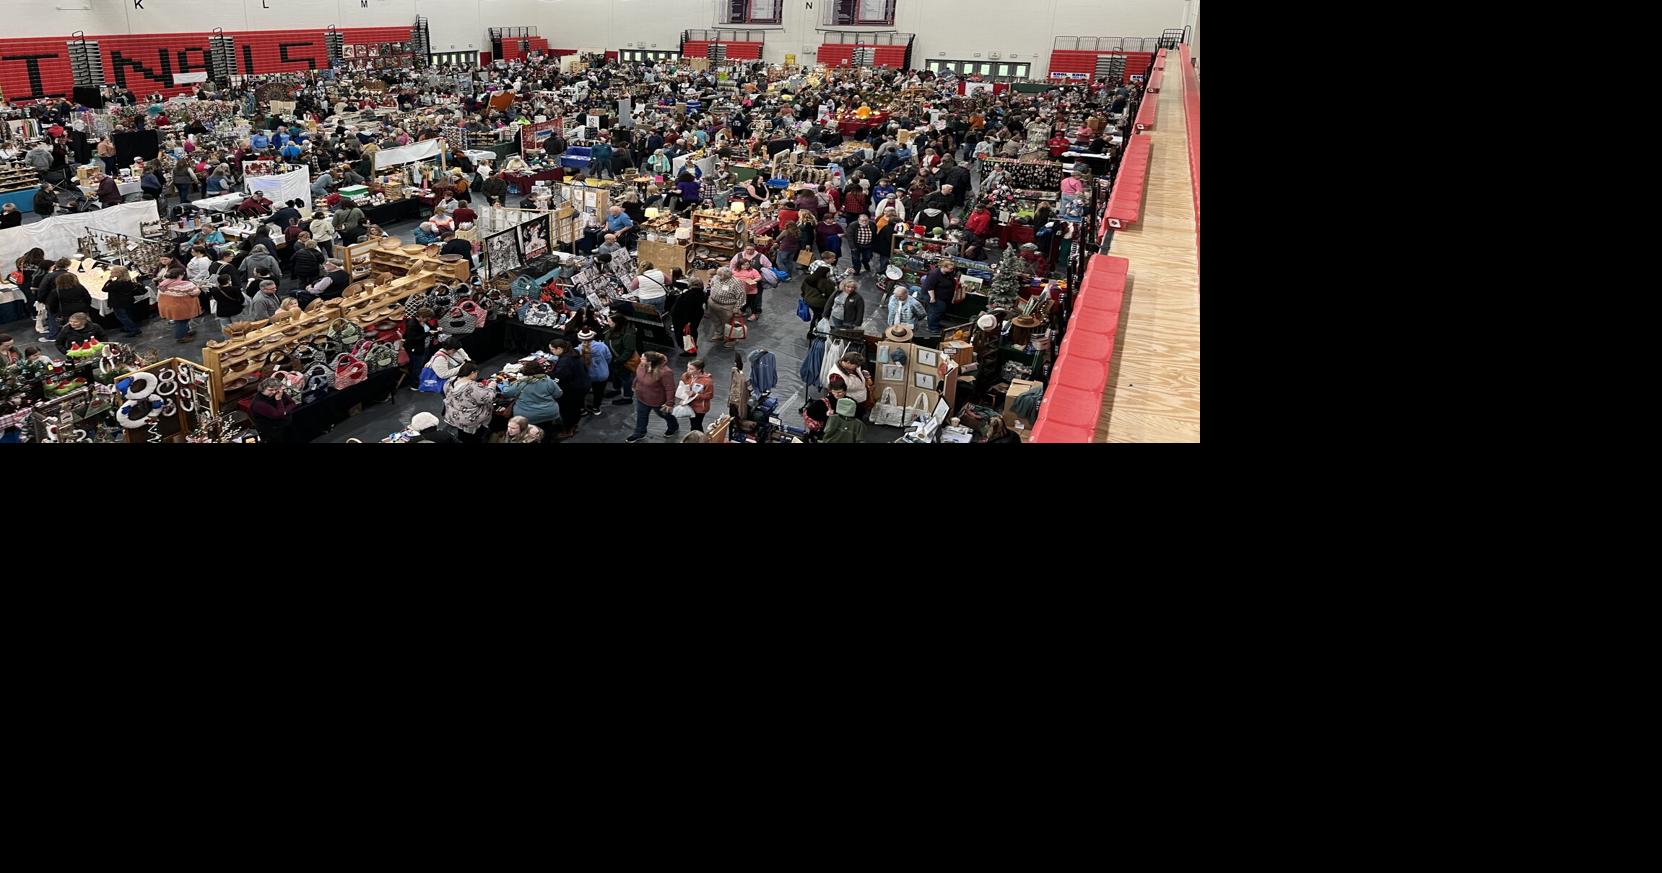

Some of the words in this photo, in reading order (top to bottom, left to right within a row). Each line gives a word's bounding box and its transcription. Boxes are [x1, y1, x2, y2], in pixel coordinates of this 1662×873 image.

[134, 0, 144, 9] K
[262, 0, 270, 8] L
[805, 1, 813, 10] N
